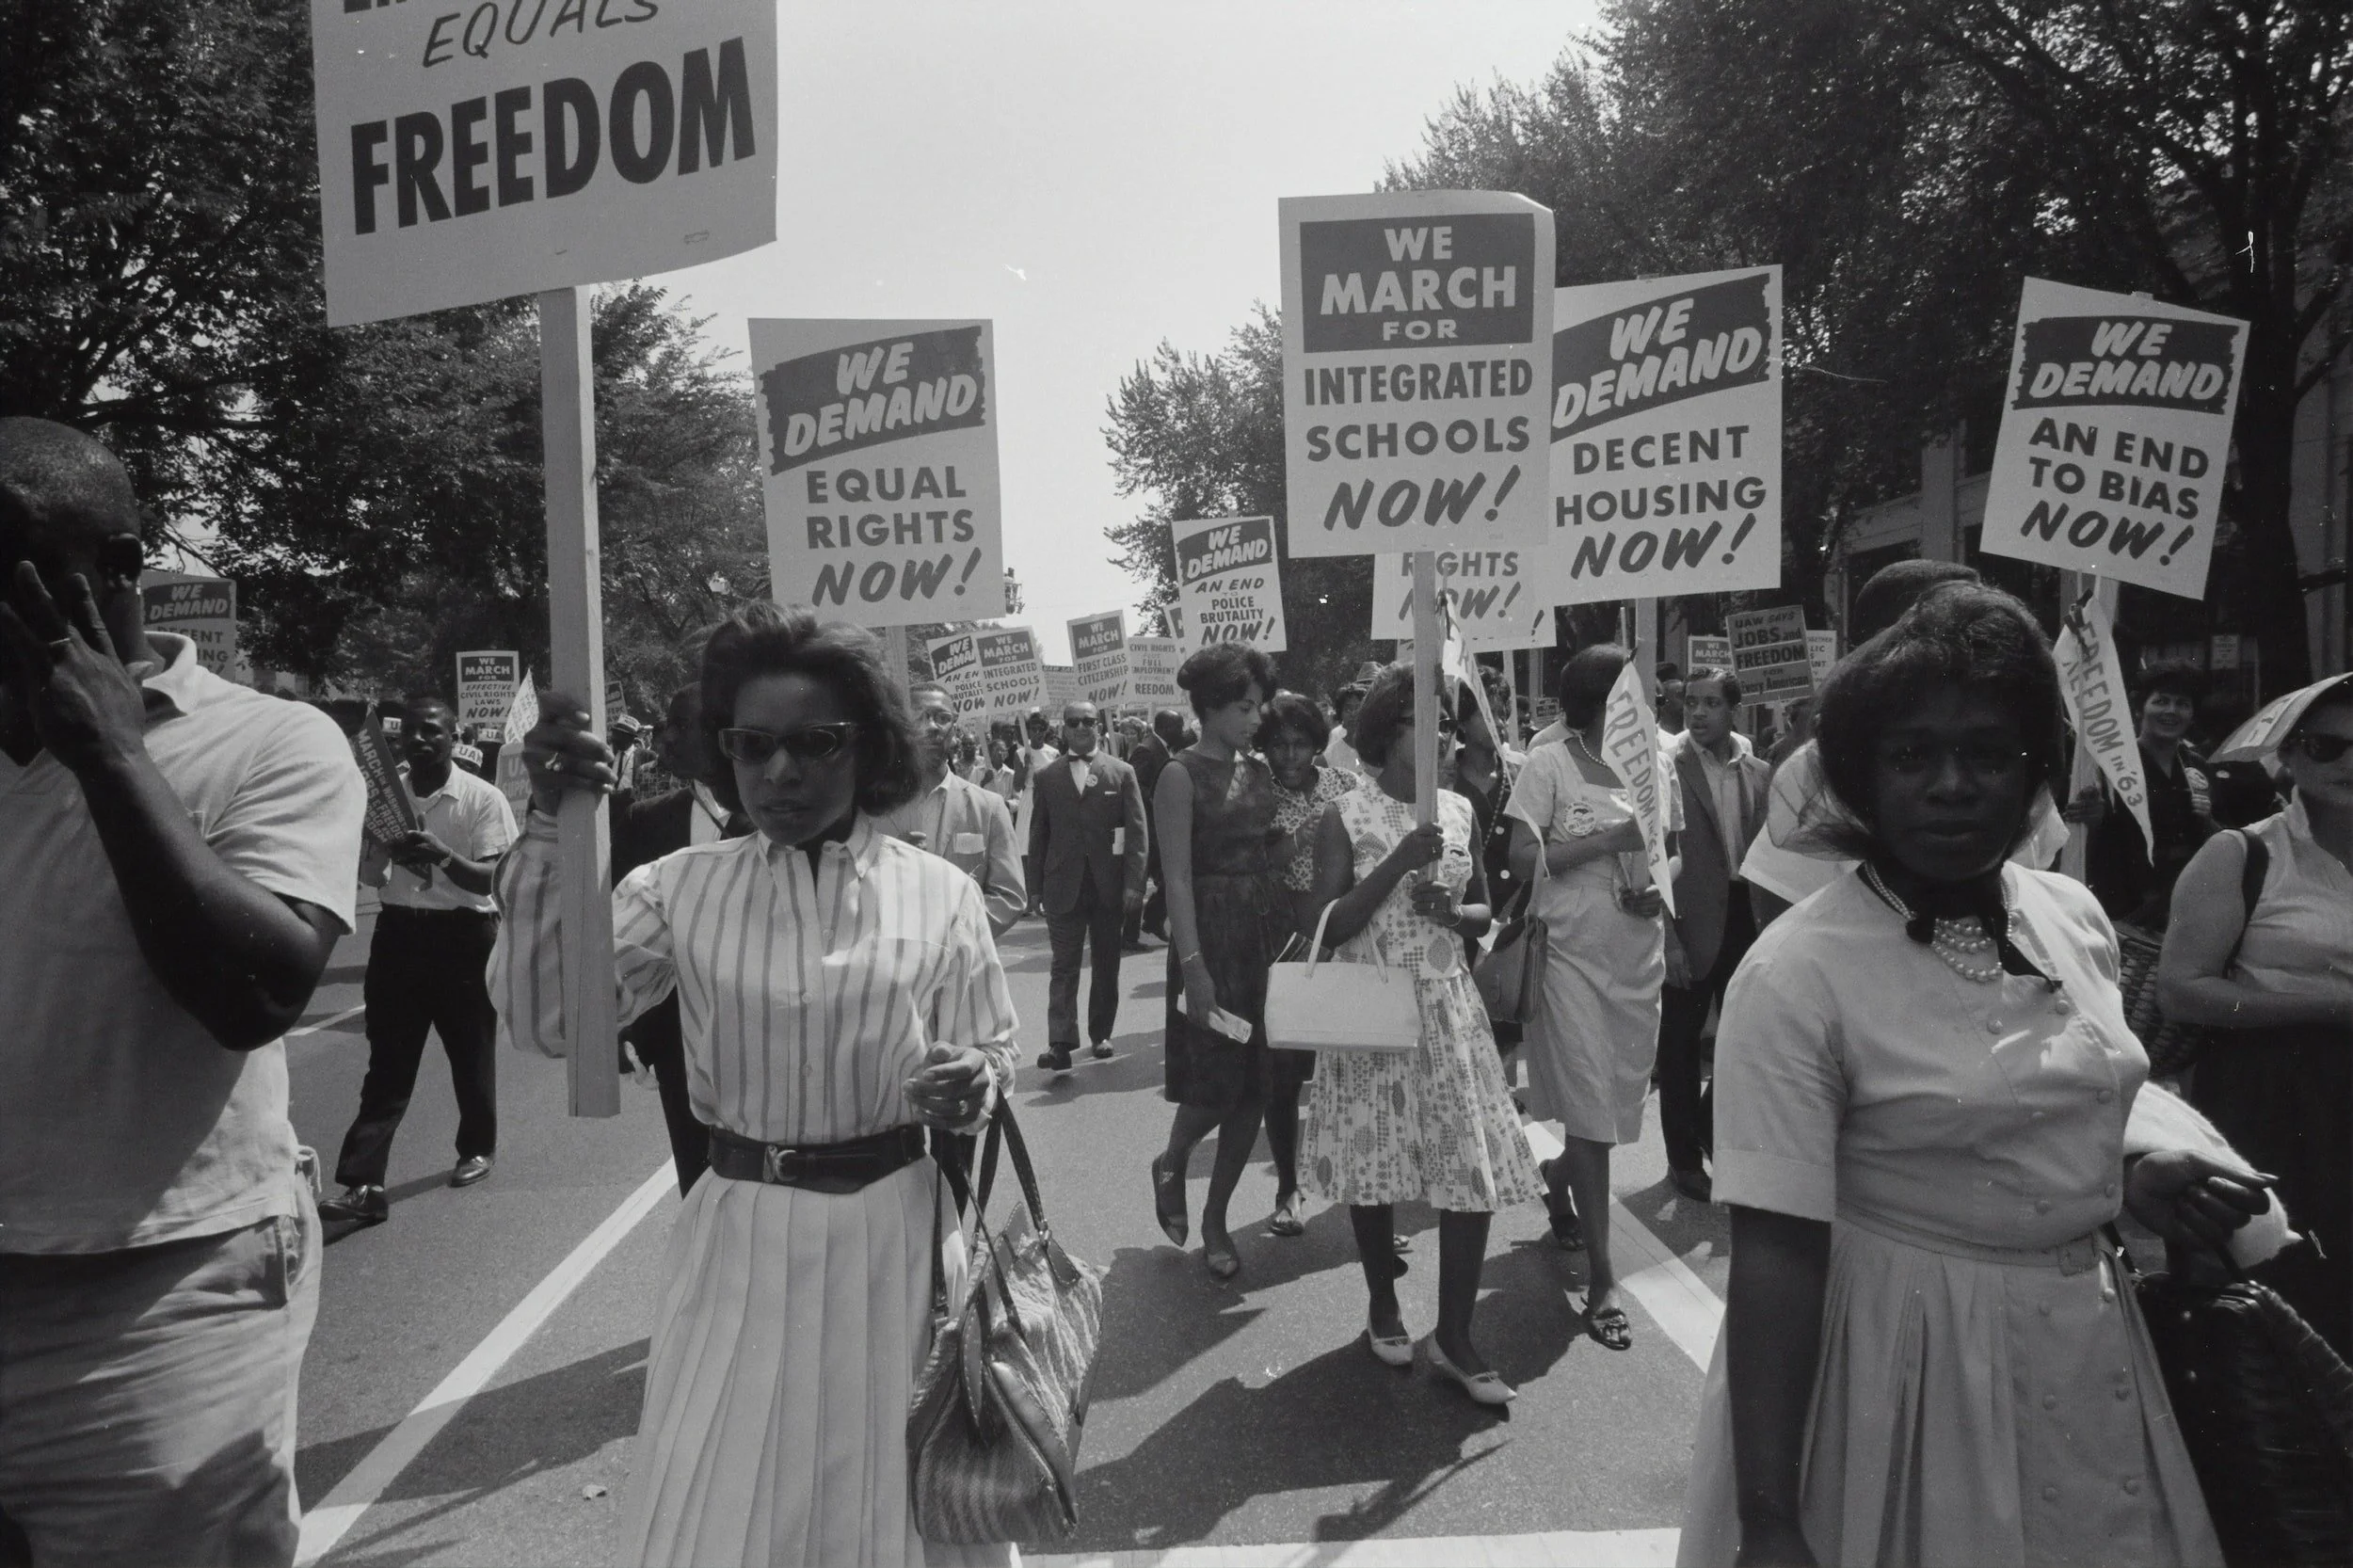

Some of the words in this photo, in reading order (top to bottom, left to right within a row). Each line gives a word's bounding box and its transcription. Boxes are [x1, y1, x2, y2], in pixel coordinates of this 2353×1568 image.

[423, 0, 658, 68] EQUALS
[350, 36, 756, 235] FREEDOM
[1384, 226, 1453, 262] WE
[1320, 265, 1516, 315] MARCH
[1382, 319, 1458, 341] FOR
[1609, 297, 1694, 361] WE
[2090, 321, 2171, 357] WE
[837, 342, 914, 395] WE
[1552, 327, 1762, 429] DEMAND
[2029, 360, 2224, 399] DEMAND
[1305, 359, 1533, 407] INTEGRATED
[784, 375, 977, 456] DEMAND
[1305, 416, 1529, 462] SCHOOLS
[1573, 425, 1749, 475] DECENT
[2028, 417, 2098, 456] AN
[2114, 431, 2208, 478] END
[807, 466, 967, 504] EQUAL
[2028, 456, 2085, 494] TO
[2099, 471, 2199, 520] BIAS
[1323, 465, 1521, 531] NOW!
[1556, 476, 1767, 527] HOUSING
[807, 509, 974, 550] RIGHTS
[1209, 525, 1241, 551] WE
[2020, 500, 2194, 566] NOW!
[1187, 538, 1268, 579] DEMAND
[1570, 513, 1756, 581] NOW!
[1401, 551, 1519, 577] RGHTS
[812, 547, 982, 607] NOW!
[1194, 580, 1223, 593] AN
[1228, 577, 1265, 591] END
[171, 584, 204, 600] WE
[1211, 596, 1255, 610] POLICE
[150, 598, 228, 620] DEMAND
[1200, 609, 1263, 624] BRUTALITY
[1736, 616, 1762, 629] UAW
[1769, 612, 1794, 623] SAYS
[1079, 629, 1119, 649] MARCH
[1090, 622, 1104, 632] WE
[1201, 616, 1275, 646] NOW!
[1734, 626, 1781, 648] JOBS
[1784, 627, 1801, 641] and
[950, 637, 970, 656] WE
[984, 642, 1029, 659] MARCH
[996, 635, 1013, 645] WE
[1093, 645, 1108, 653] FOR
[1129, 644, 1148, 653] CIVIL
[1150, 644, 1176, 653] RIGHTS
[479, 657, 495, 665] WE
[938, 649, 976, 675] DEMA
[1078, 658, 1100, 673] FIRST
[1102, 653, 1127, 666] CLASS
[1695, 648, 1732, 658] MARCH
[1736, 644, 1807, 669] FREEDOM
[465, 665, 511, 676] MARCH
[944, 672, 960, 683] AN
[965, 670, 979, 679] EN
[984, 662, 1037, 679] INTEGRATED
[1078, 664, 1129, 686] CITIZENSHIP
[466, 683, 512, 692] EFFECTIVE
[955, 680, 982, 692] POLICE
[986, 675, 1040, 692] SCHOOLS
[1088, 680, 1128, 703] NOW!
[1135, 682, 1174, 695] REEDOM
[1766, 676, 1809, 691] American
[2077, 621, 2125, 754] FREEDOM
[994, 687, 1040, 708] NOW!
[358, 728, 384, 777] MARCH
[1604, 690, 1656, 819] FREEDOM
[2110, 755, 2125, 772] IN
[2117, 771, 2143, 807] '63
